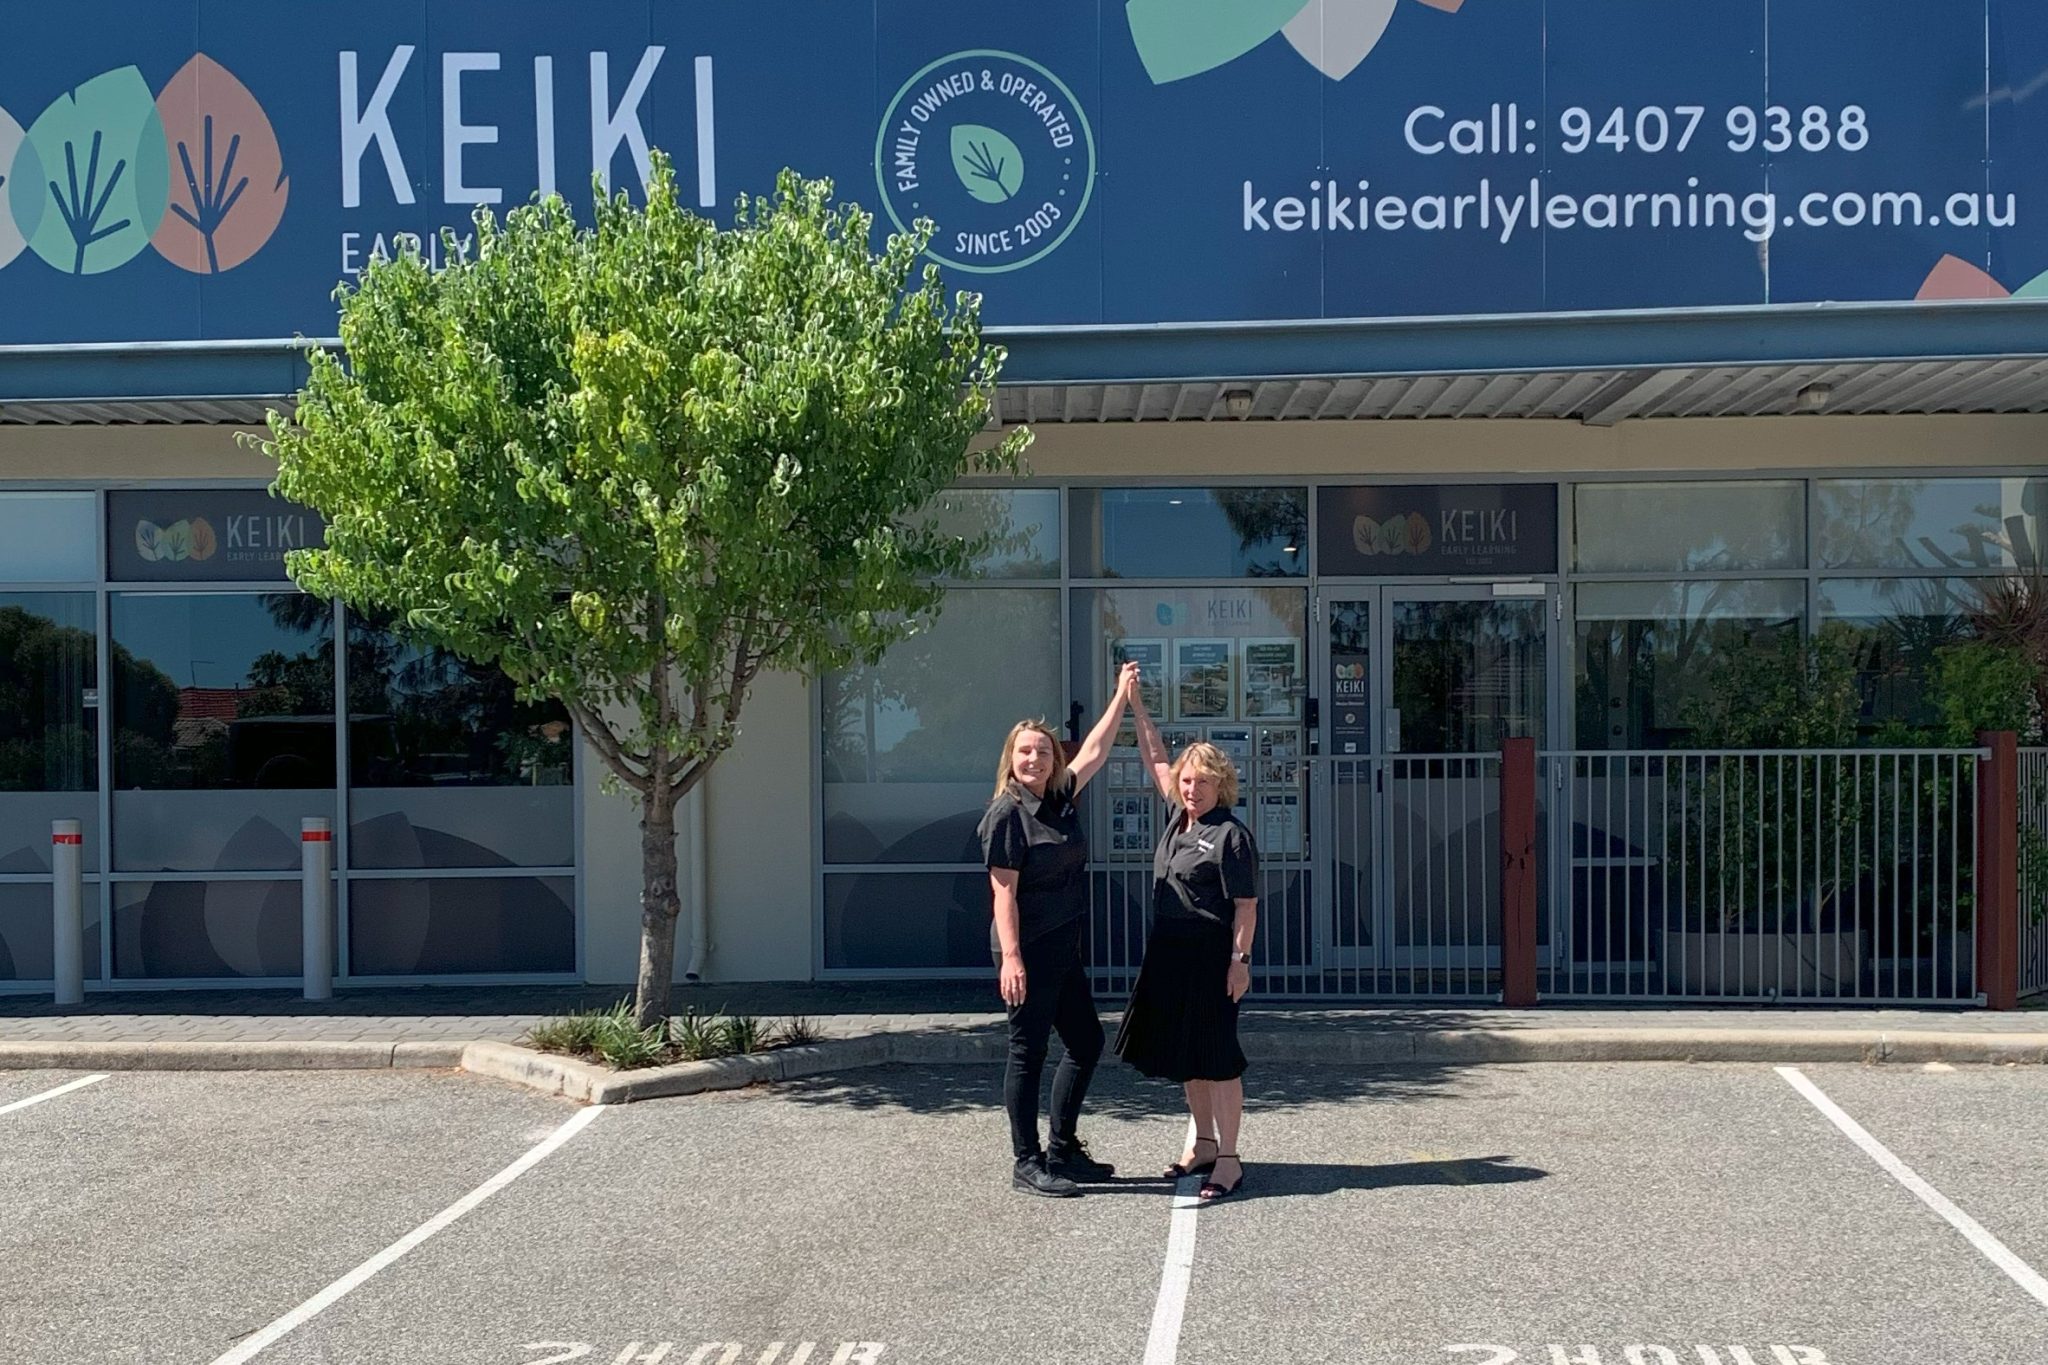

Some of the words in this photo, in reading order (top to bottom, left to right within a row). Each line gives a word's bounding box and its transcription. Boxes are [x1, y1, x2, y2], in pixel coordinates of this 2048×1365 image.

[339, 45, 716, 208] KEIKI
[895, 120, 921, 192] FAMILY
[910, 71, 975, 122] OWNED
[980, 69, 995, 91] &
[1000, 73, 1074, 149] OPERATED
[1403, 103, 1537, 154] Call:
[1560, 105, 1705, 153] 9407
[1726, 105, 1869, 152] 9388
[955, 230, 1013, 255] SINCE
[1014, 202, 1061, 245] 2003
[1242, 177, 2017, 243] keikiearlylearning.com.au
[226, 514, 305, 548] KEIKI
[1440, 508, 1517, 542] KEIKI
[1207, 599, 1253, 619] KEIKI
[1335, 680, 1365, 693] KEIKI
